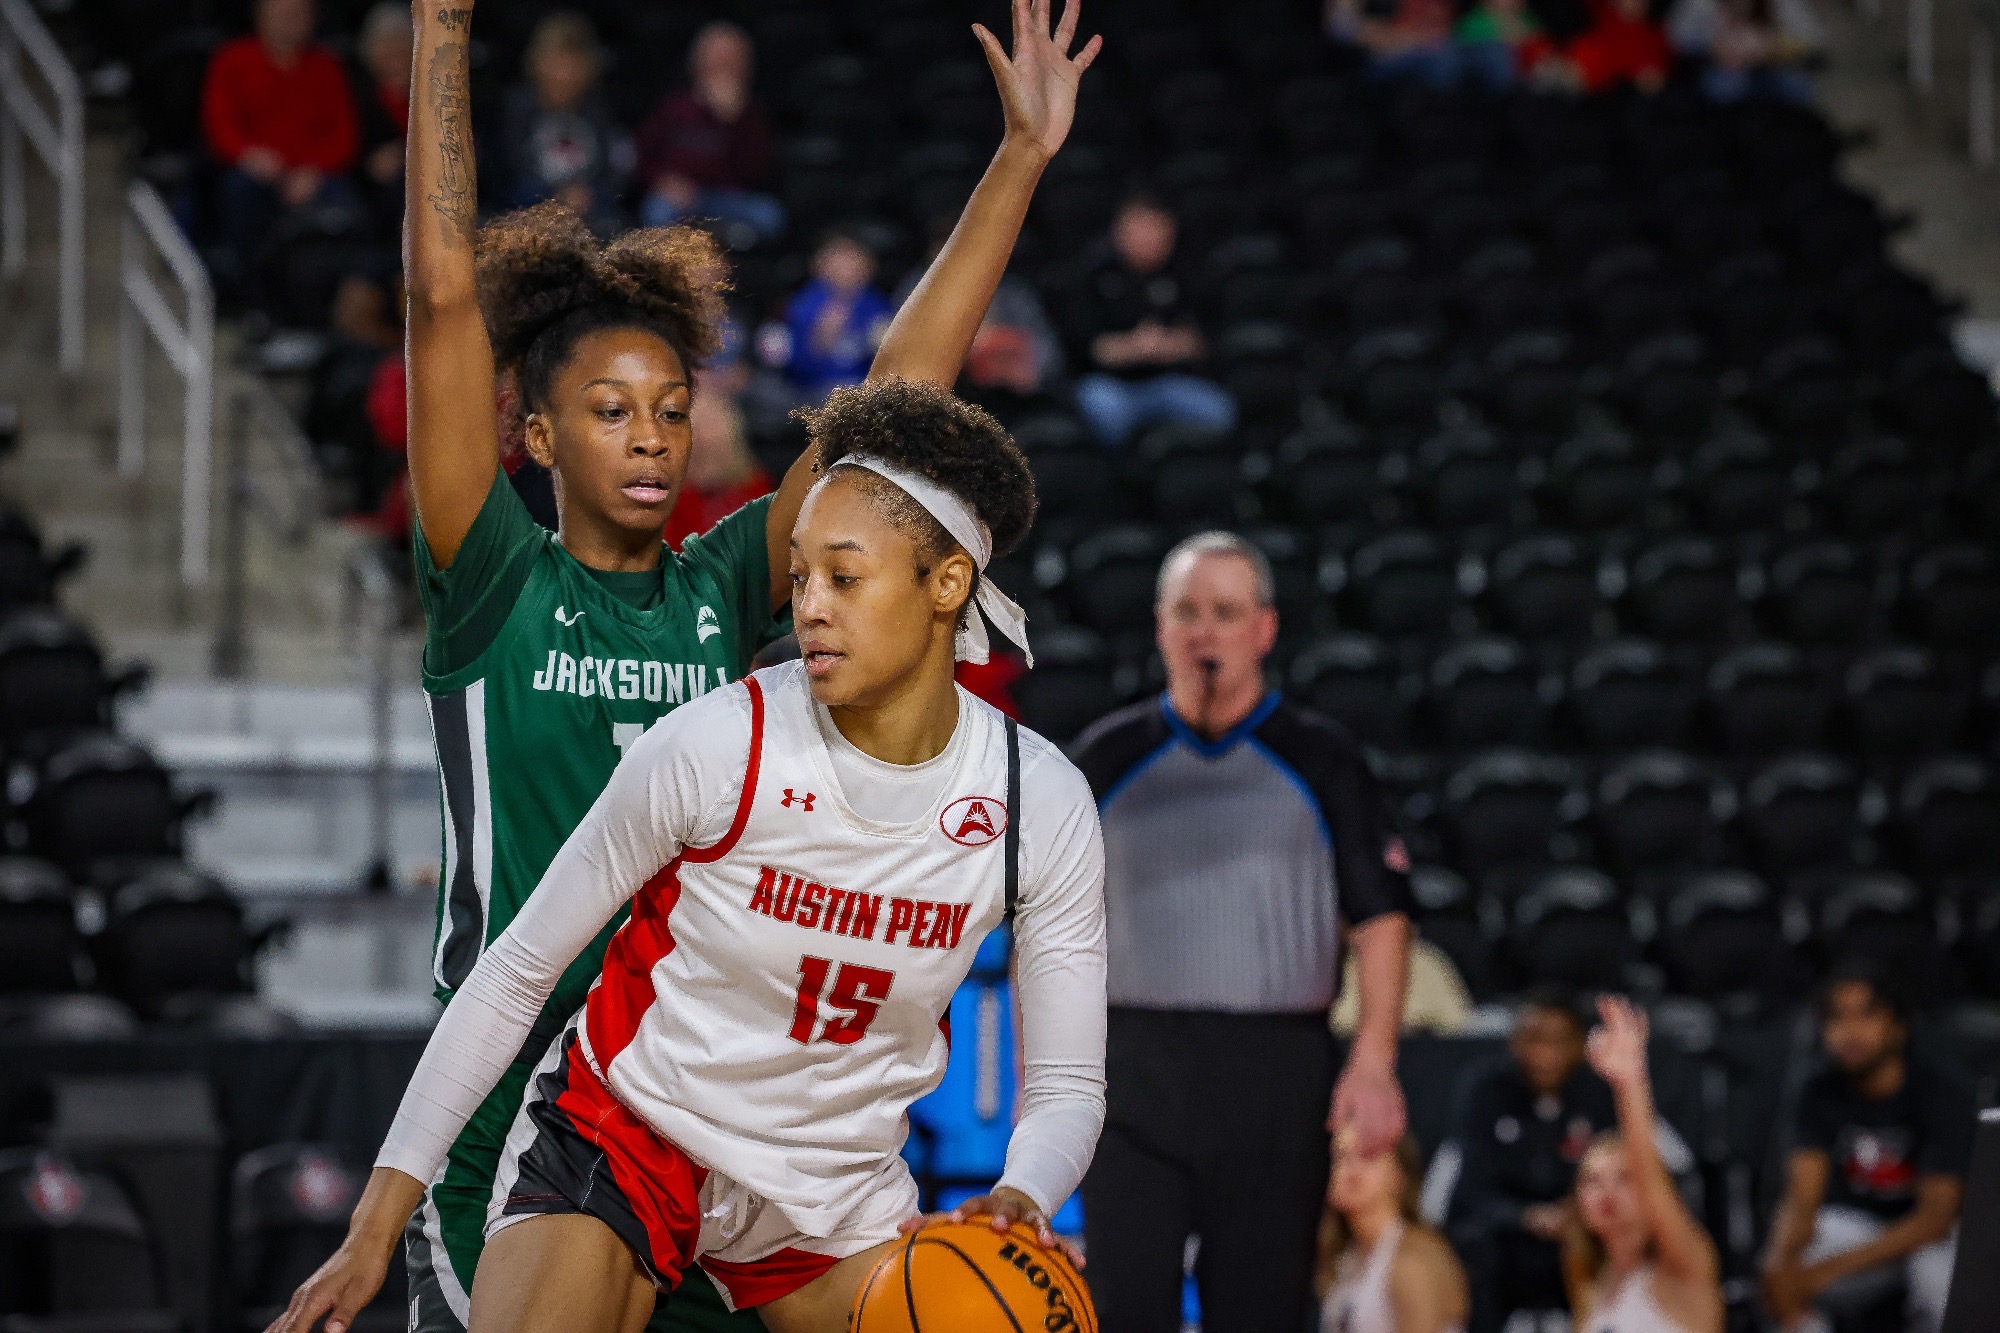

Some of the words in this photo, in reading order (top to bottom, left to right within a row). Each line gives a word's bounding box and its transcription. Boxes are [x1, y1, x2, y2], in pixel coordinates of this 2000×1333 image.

[533, 650, 728, 704] JACKSONV
[746, 865, 884, 941] AUSTIN
[786, 954, 896, 1046] 15
